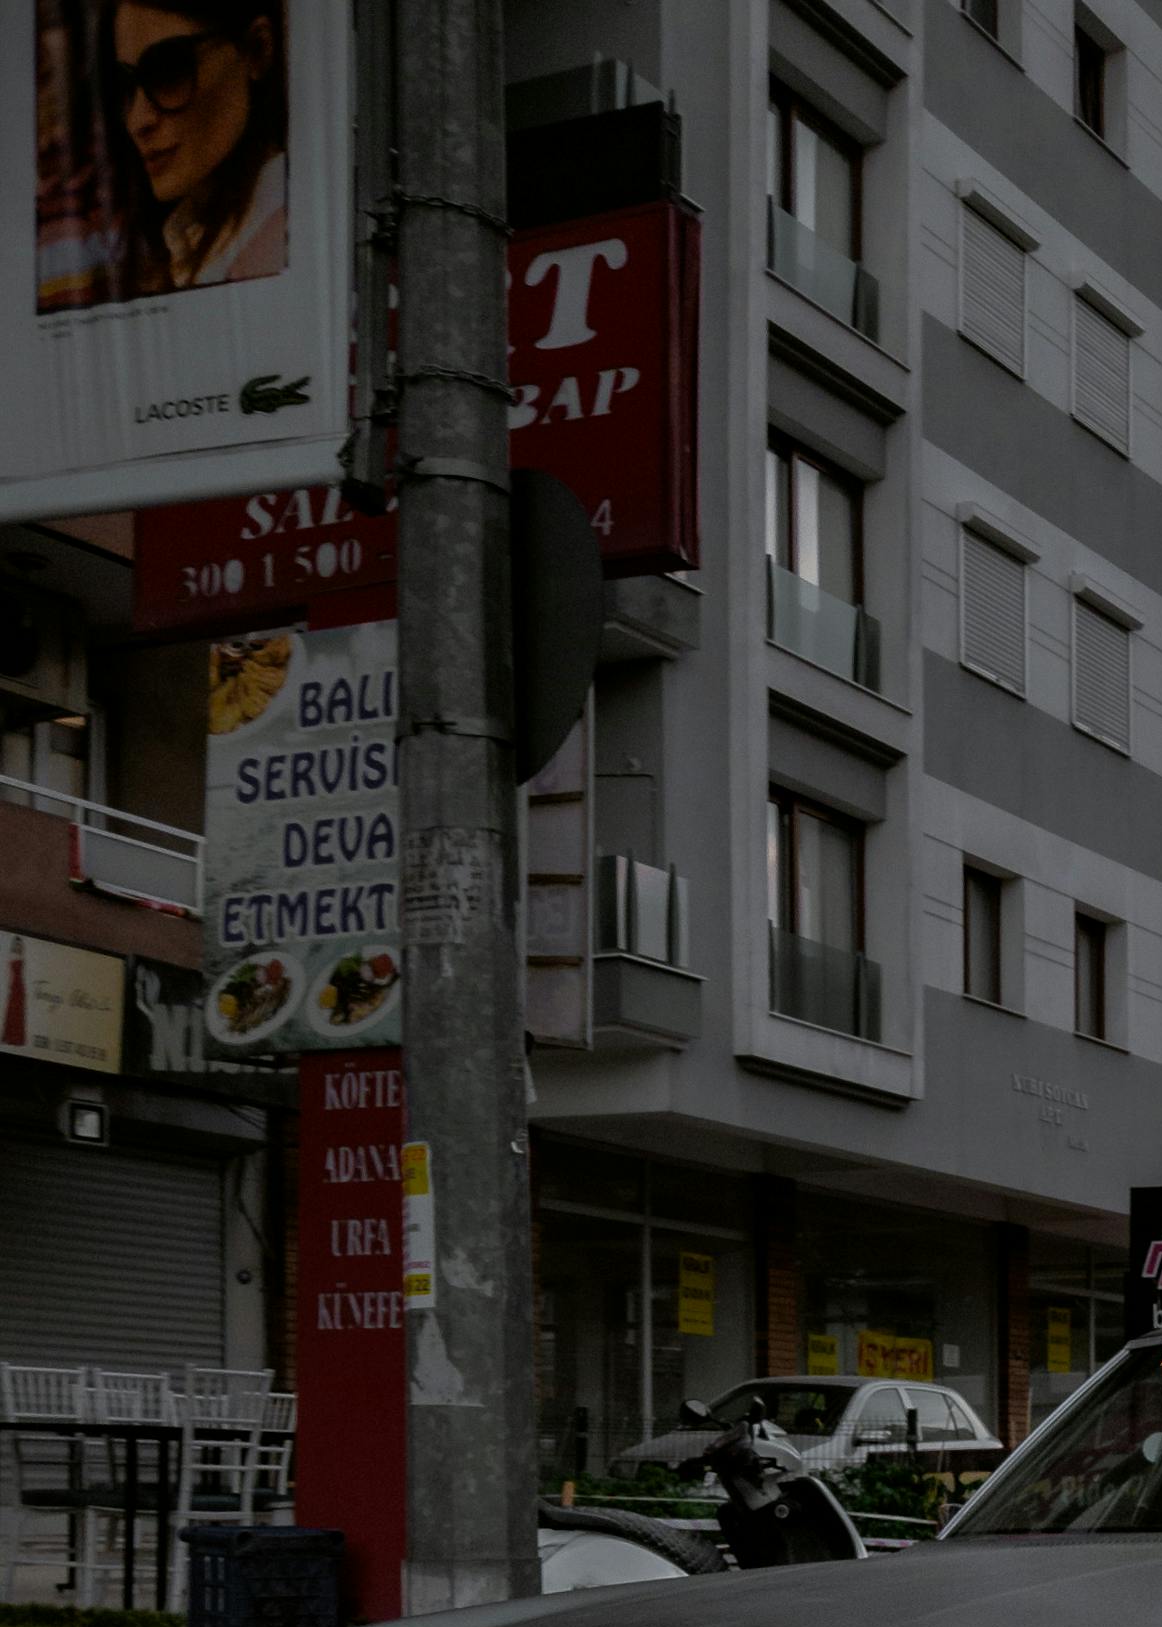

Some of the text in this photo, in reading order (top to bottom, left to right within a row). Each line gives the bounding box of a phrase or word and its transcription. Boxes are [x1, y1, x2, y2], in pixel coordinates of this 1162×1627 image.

[506, 237, 629, 350] T
[134, 394, 230, 424] LACOSTE
[301, 670, 393, 728] BALI
[284, 812, 395, 868] DEVA
[323, 1062, 401, 1111] KÖFTE
[322, 1143, 401, 1184] ADANA
[331, 1218, 392, 1257] URFA
[317, 1281, 402, 1331] KÜNEFE
